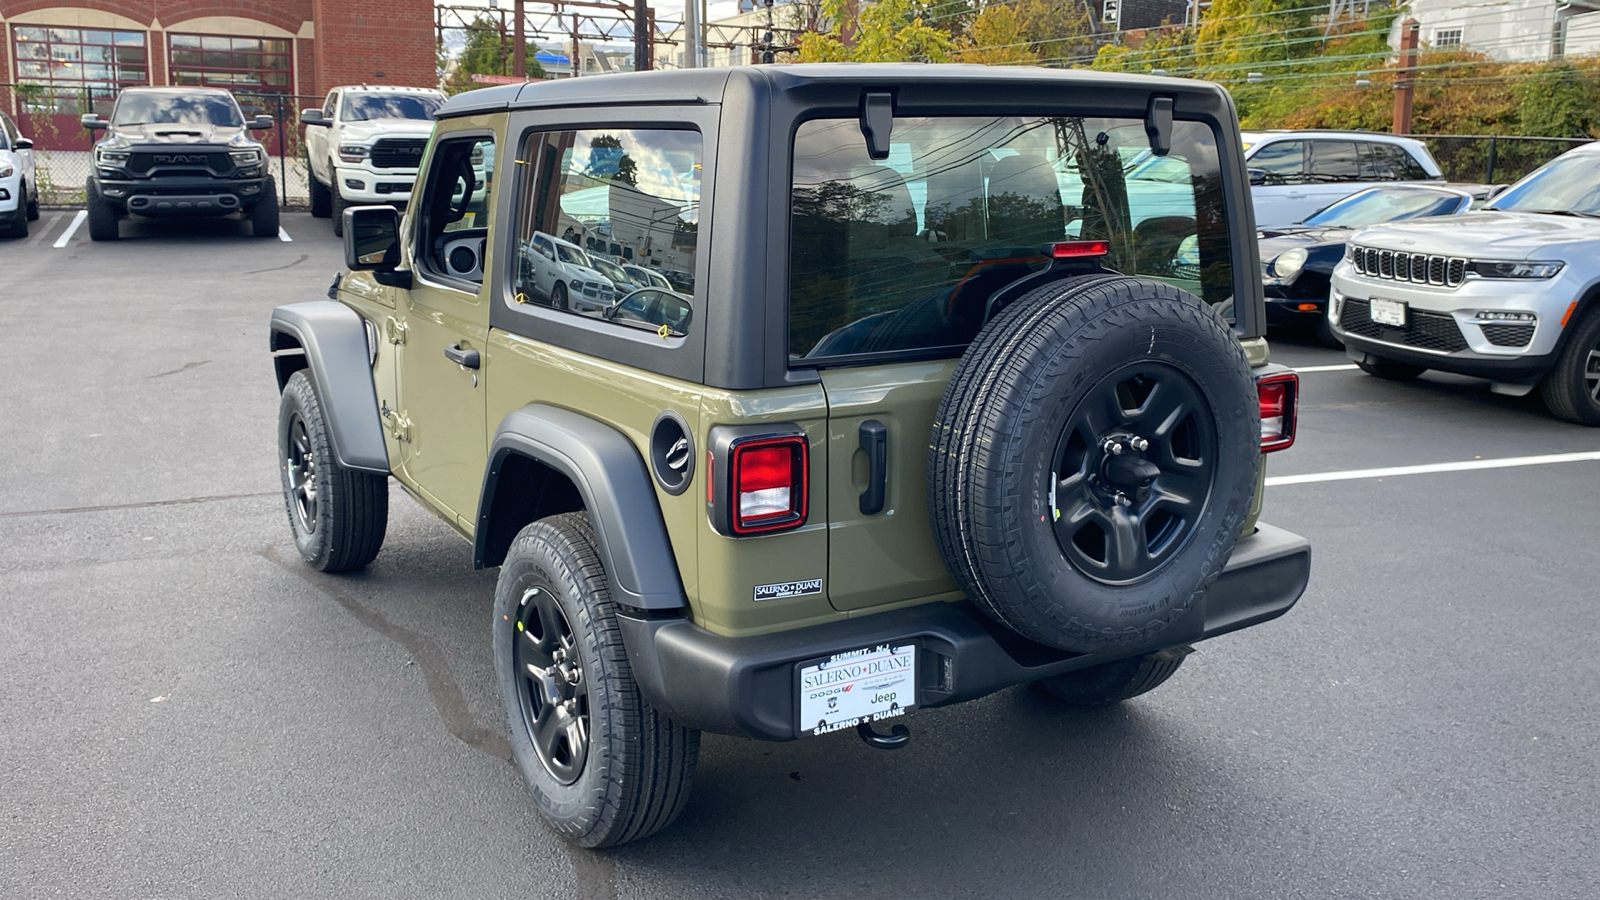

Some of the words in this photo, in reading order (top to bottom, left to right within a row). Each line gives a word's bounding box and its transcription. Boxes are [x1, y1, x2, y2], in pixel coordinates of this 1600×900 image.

[153, 155, 208, 163] RAM
[756, 585, 789, 595] SALERNO
[796, 580, 820, 591] DUANE
[804, 666, 862, 689] SALERNO
[868, 655, 911, 674] DUANE
[810, 687, 847, 700] DODGE
[870, 691, 897, 705] Jeep
[813, 718, 860, 736] SALERNO
[873, 706, 906, 722] DUANE
